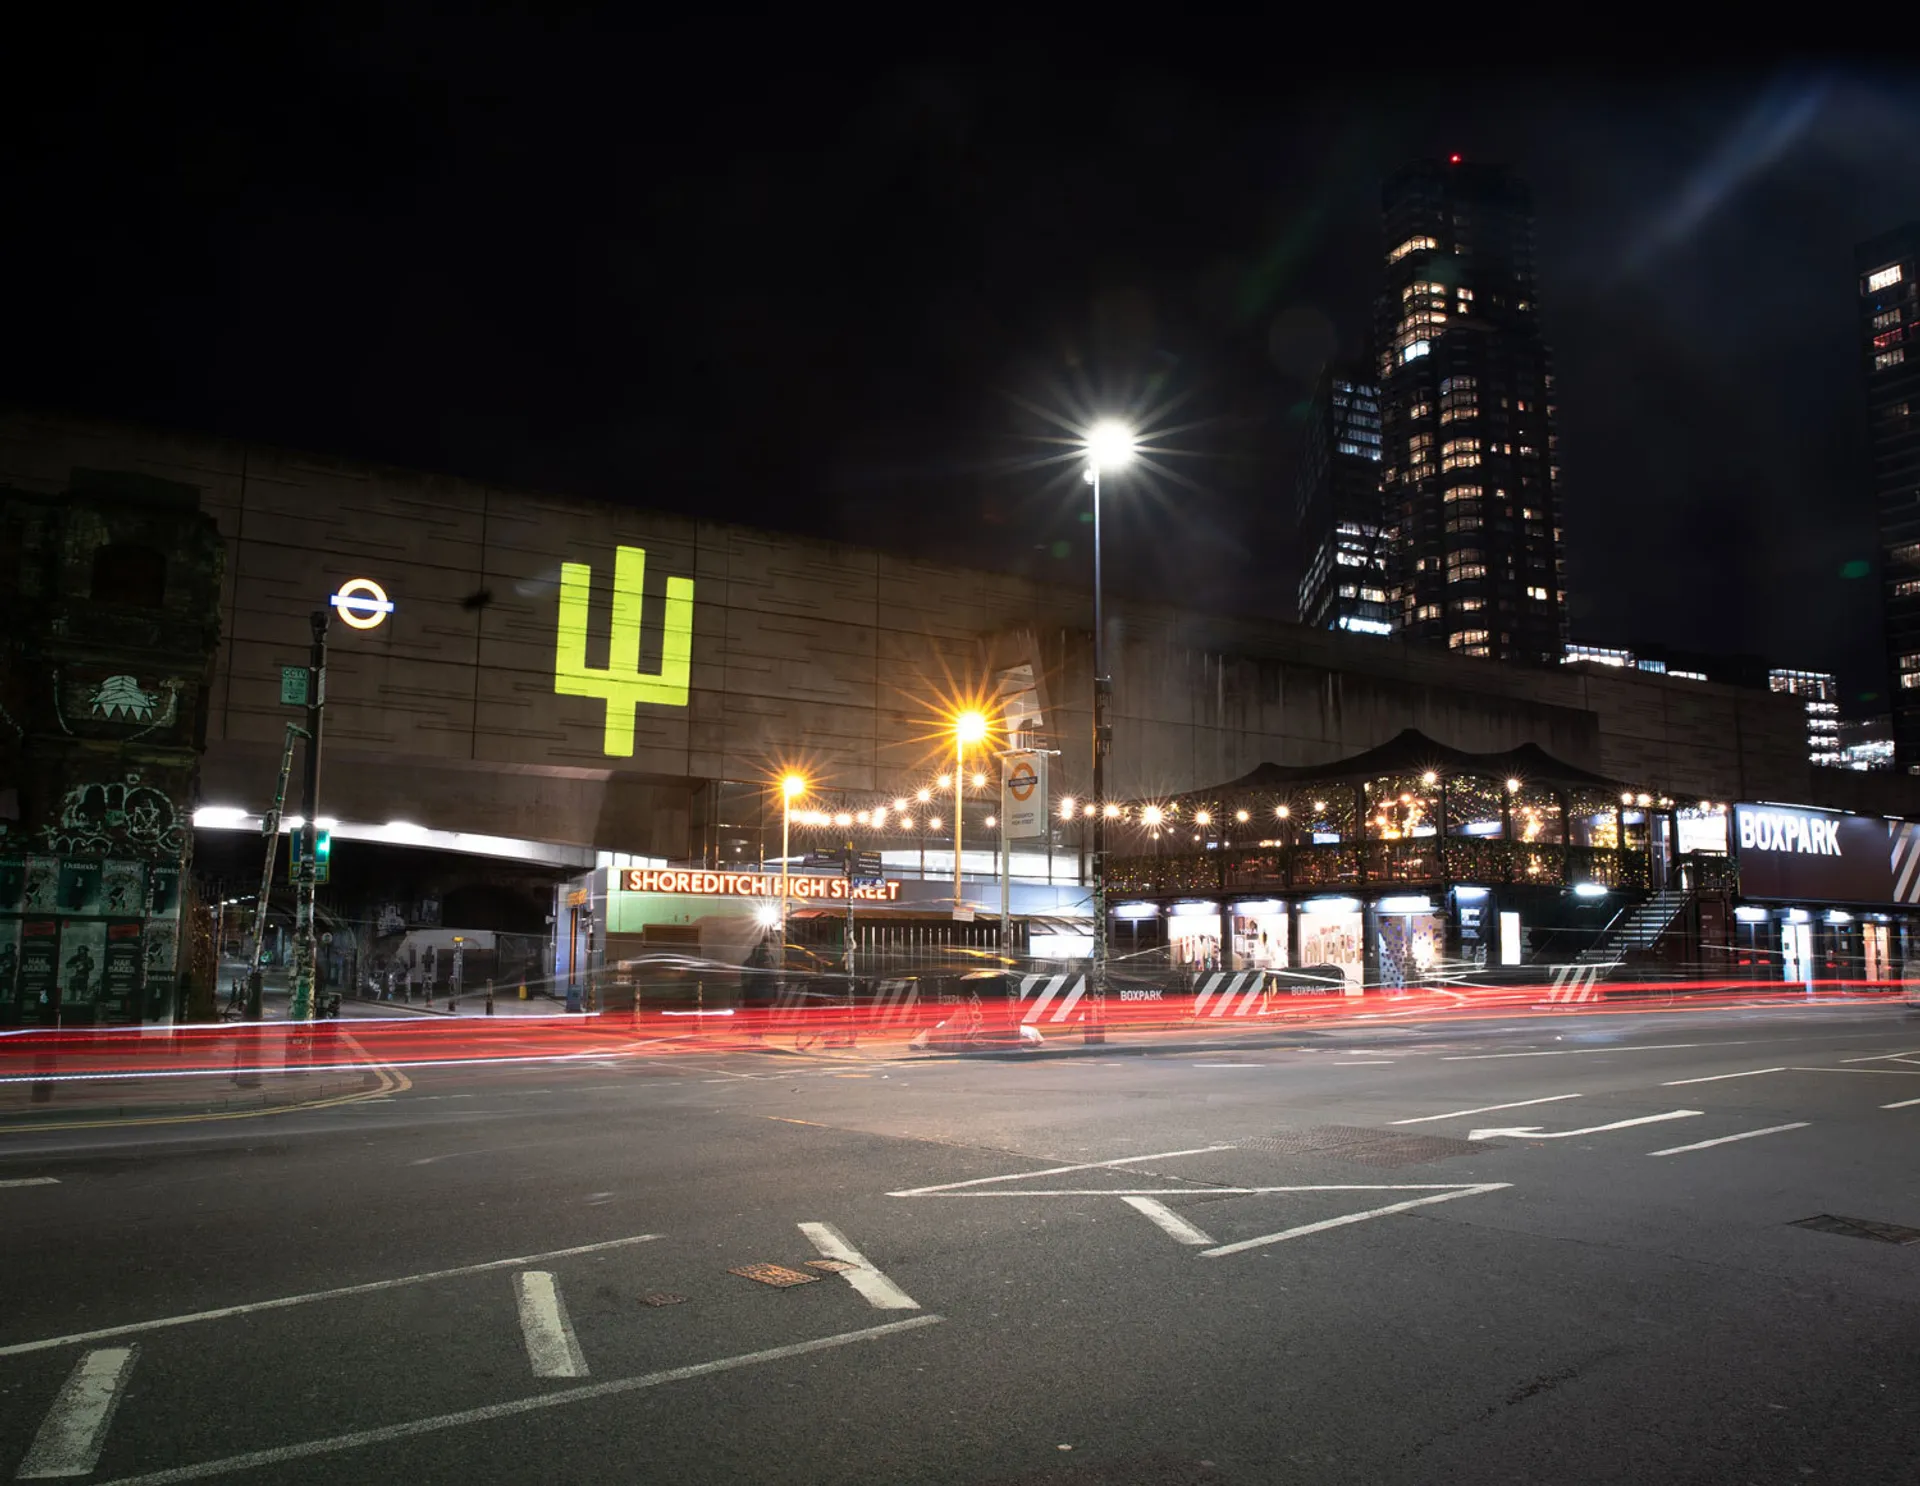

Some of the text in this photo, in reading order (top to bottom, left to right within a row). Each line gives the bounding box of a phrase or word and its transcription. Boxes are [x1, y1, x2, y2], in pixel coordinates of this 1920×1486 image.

[1738, 811, 1842, 856] BOXPARK
[63, 861, 99, 871] Outlander
[629, 870, 900, 900] SHOREDITCH HIGH STREET
[1120, 990, 1163, 1001] BOXPARK
